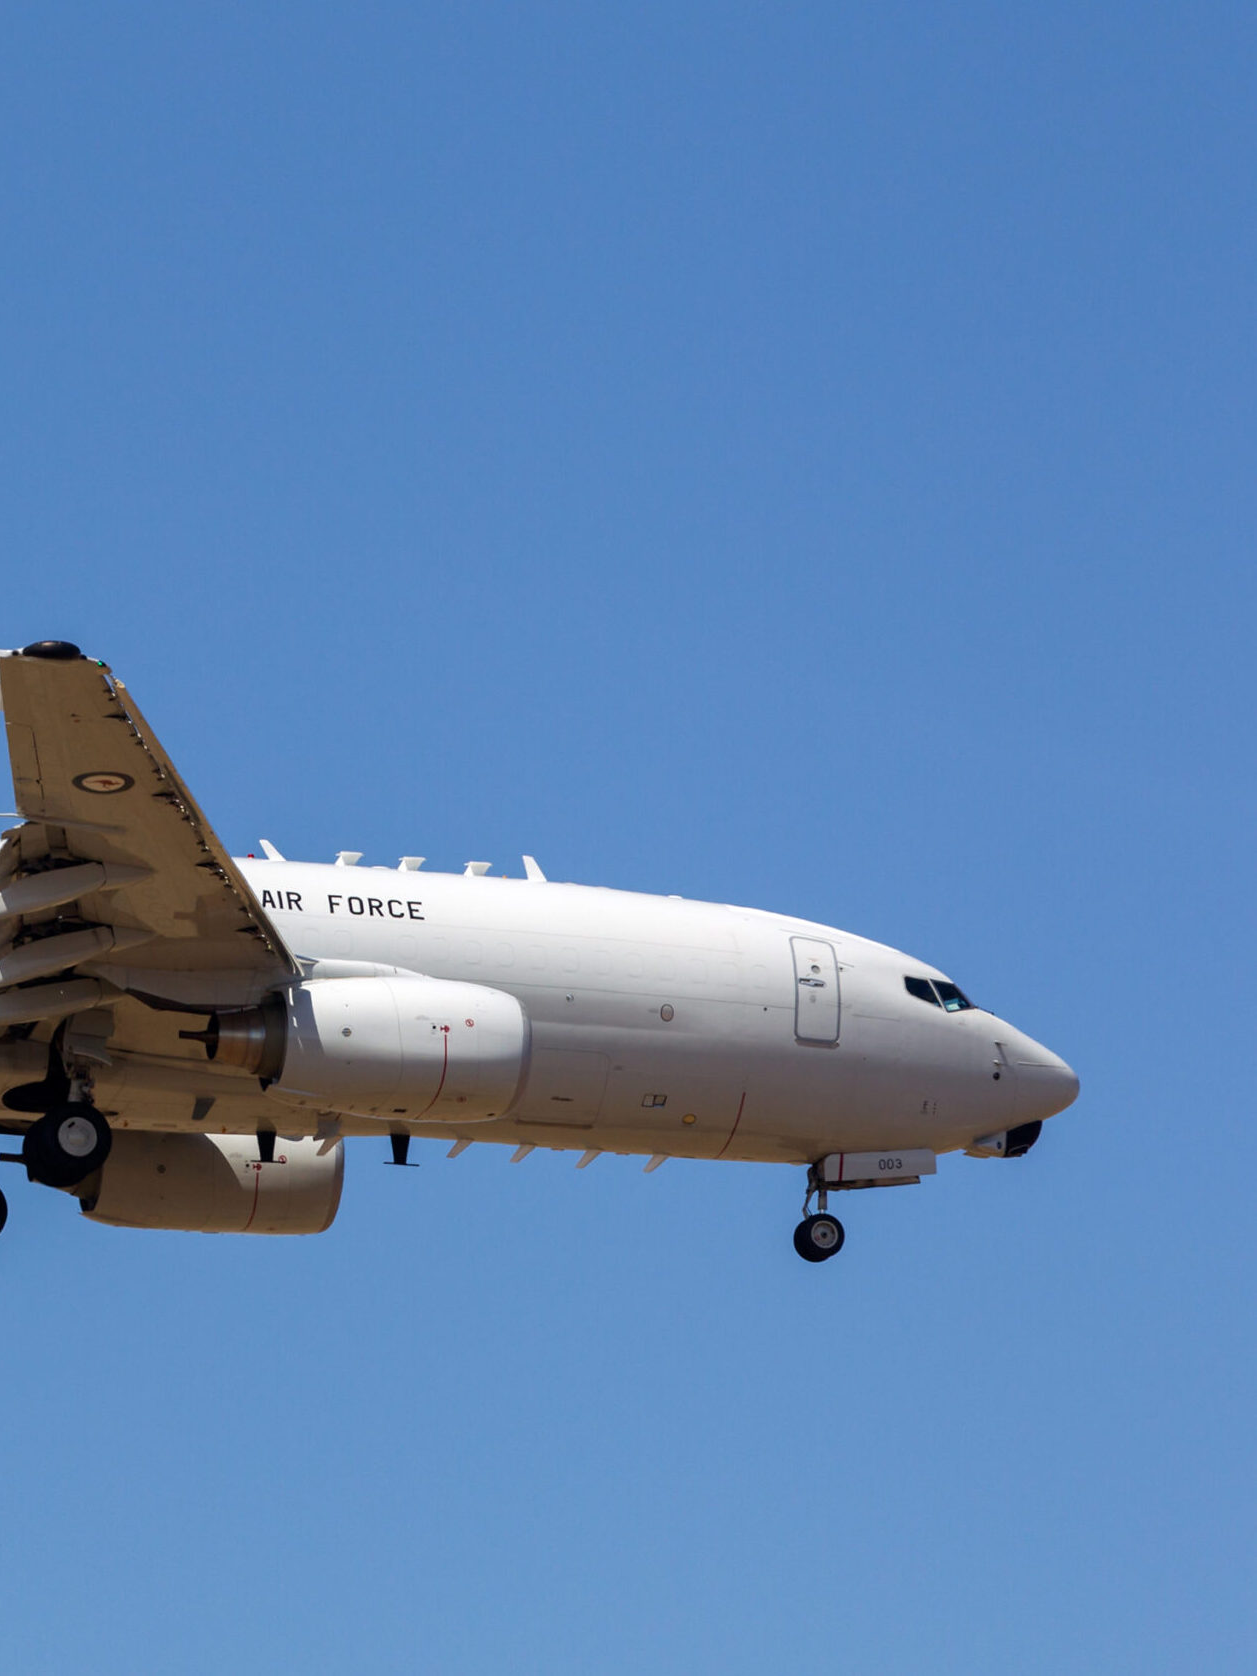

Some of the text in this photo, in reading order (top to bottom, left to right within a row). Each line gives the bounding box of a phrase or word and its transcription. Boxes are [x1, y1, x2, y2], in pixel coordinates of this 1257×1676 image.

[262, 889, 303, 911] AIR
[327, 894, 425, 920] FORCE
[878, 1158, 903, 1170] 003
